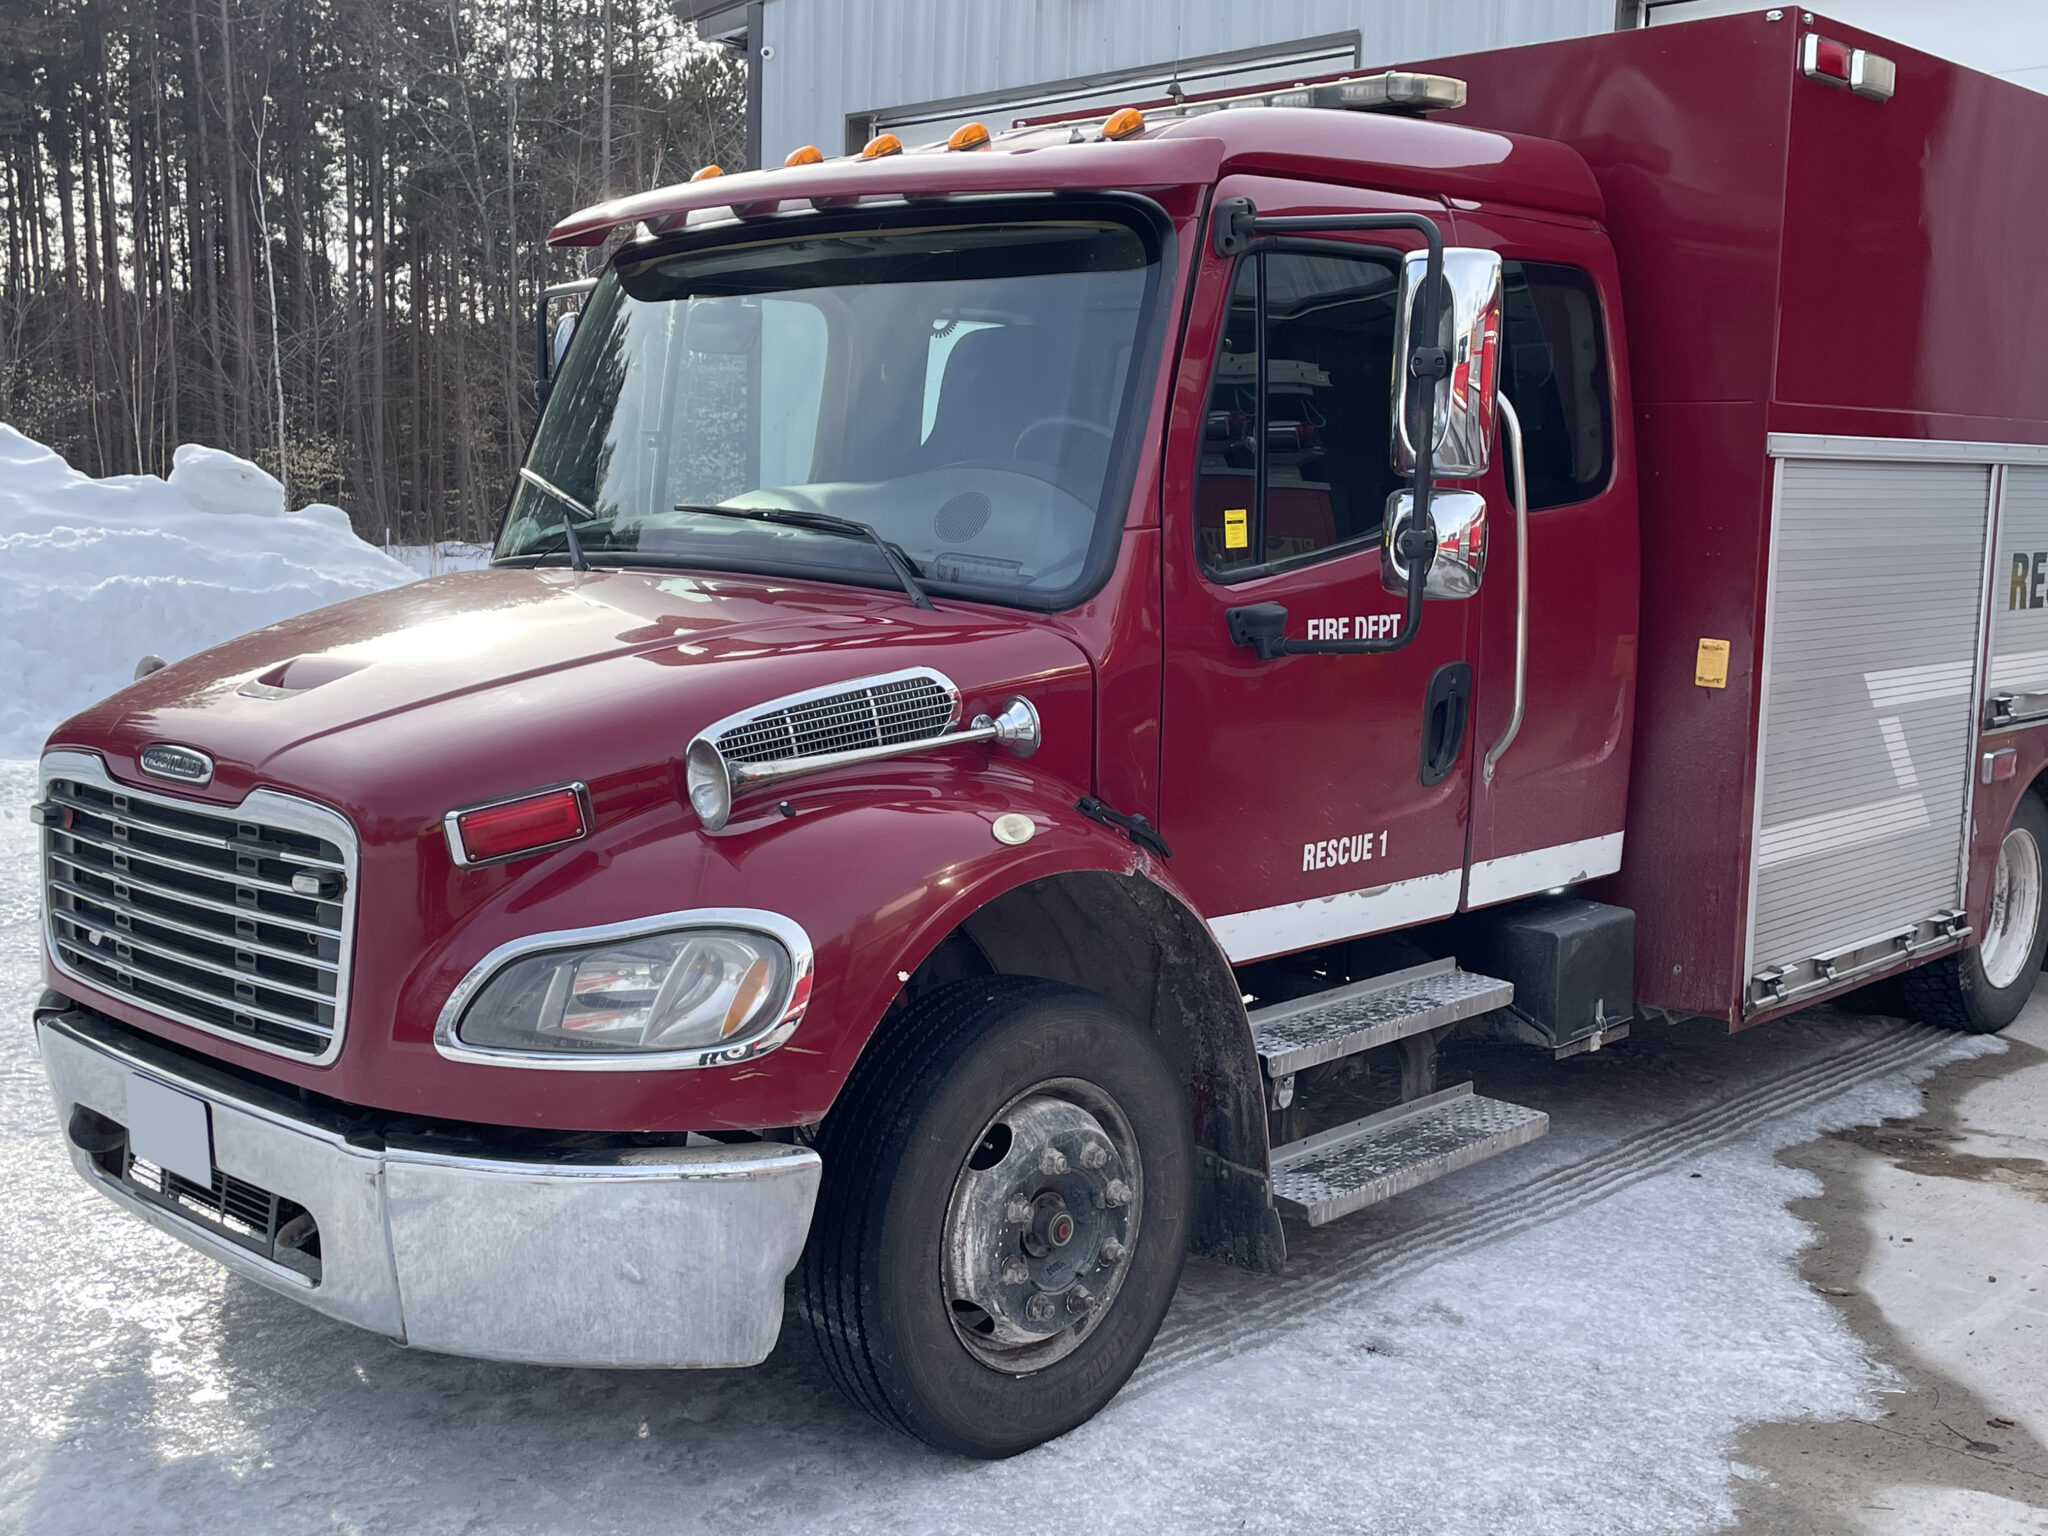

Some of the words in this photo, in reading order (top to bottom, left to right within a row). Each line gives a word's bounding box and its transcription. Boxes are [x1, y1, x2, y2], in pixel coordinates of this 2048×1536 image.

[2009, 552, 2048, 611] RE
[1307, 617, 1350, 641] FIRE
[1355, 613, 1402, 640] DEPT
[145, 751, 202, 776] FREIGHTLINER
[1302, 832, 1374, 872] RESCUE
[1379, 829, 1388, 857] 1
